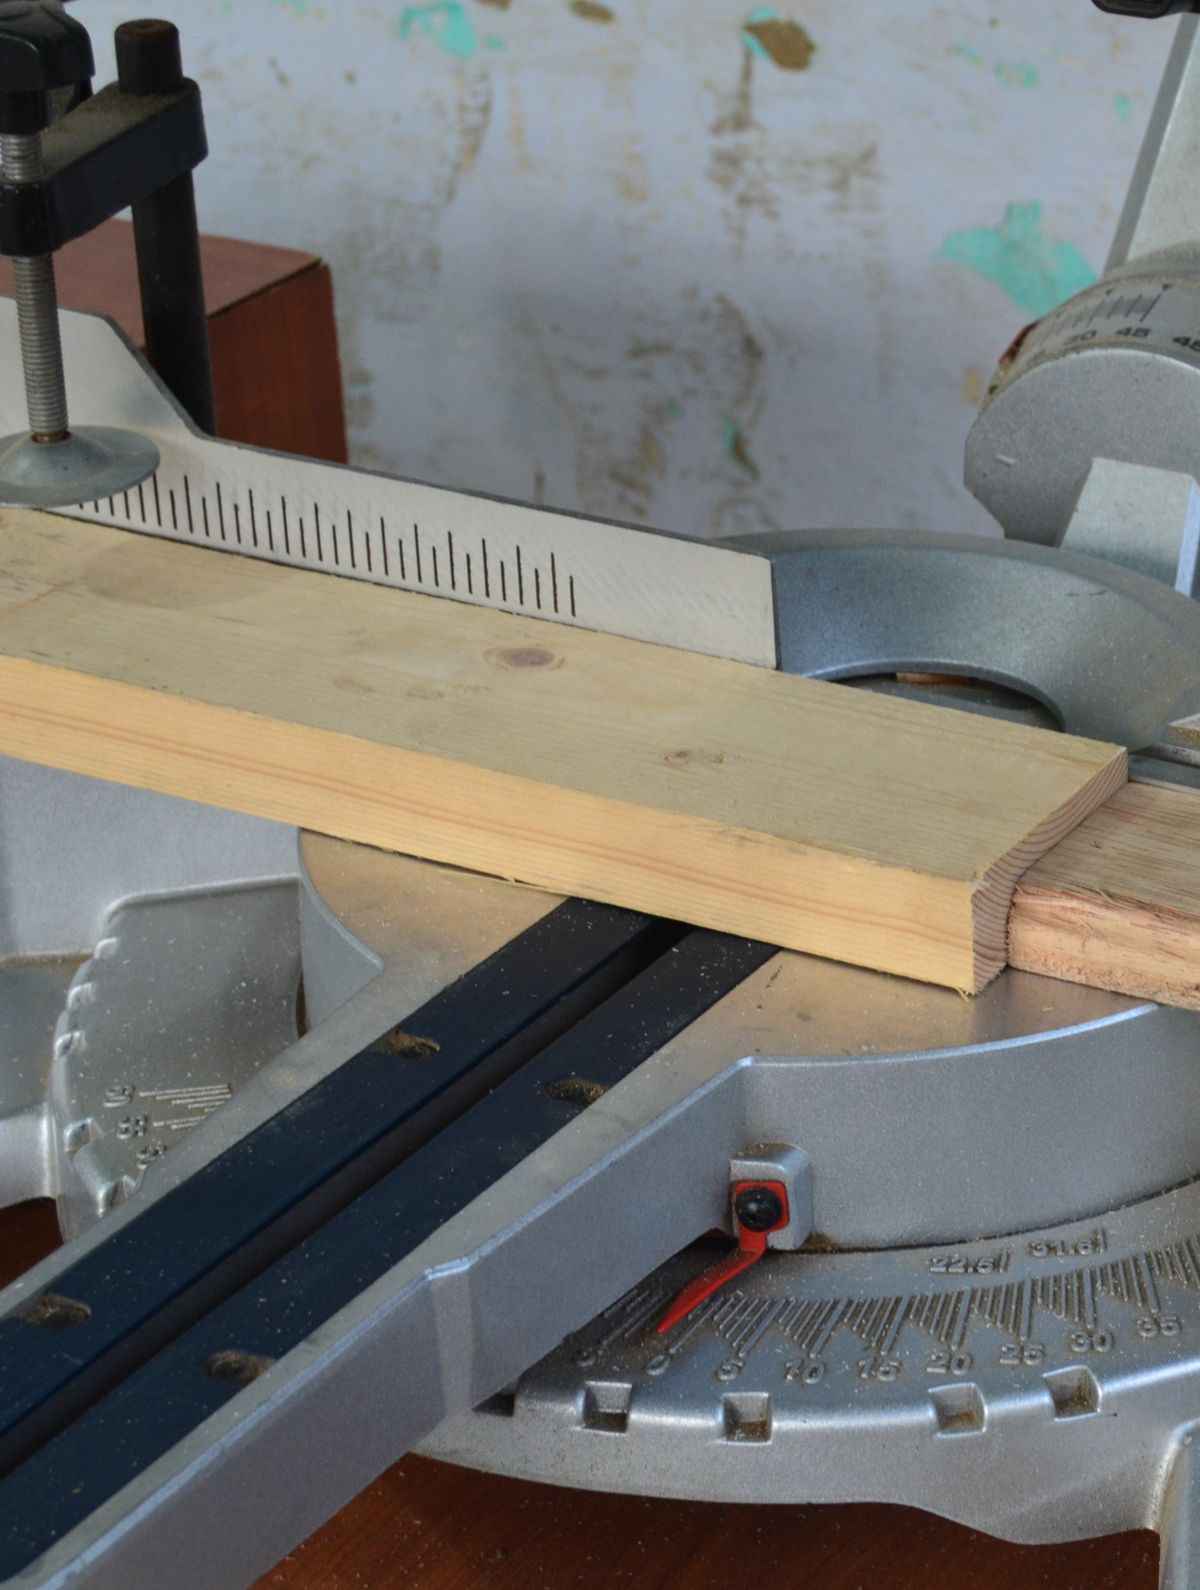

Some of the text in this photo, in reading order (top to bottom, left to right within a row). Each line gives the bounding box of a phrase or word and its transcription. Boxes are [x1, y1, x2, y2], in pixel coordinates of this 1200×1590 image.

[1115, 326, 1151, 338] 45
[929, 1257, 994, 1275] 22.5
[718, 1359, 744, 1382] 5
[785, 1358, 825, 1384] 10
[859, 1357, 898, 1383] 15
[926, 1351, 972, 1376] 20
[1000, 1343, 1043, 1366] 25
[1070, 1331, 1114, 1353] 30
[1136, 1315, 1181, 1337] 35
